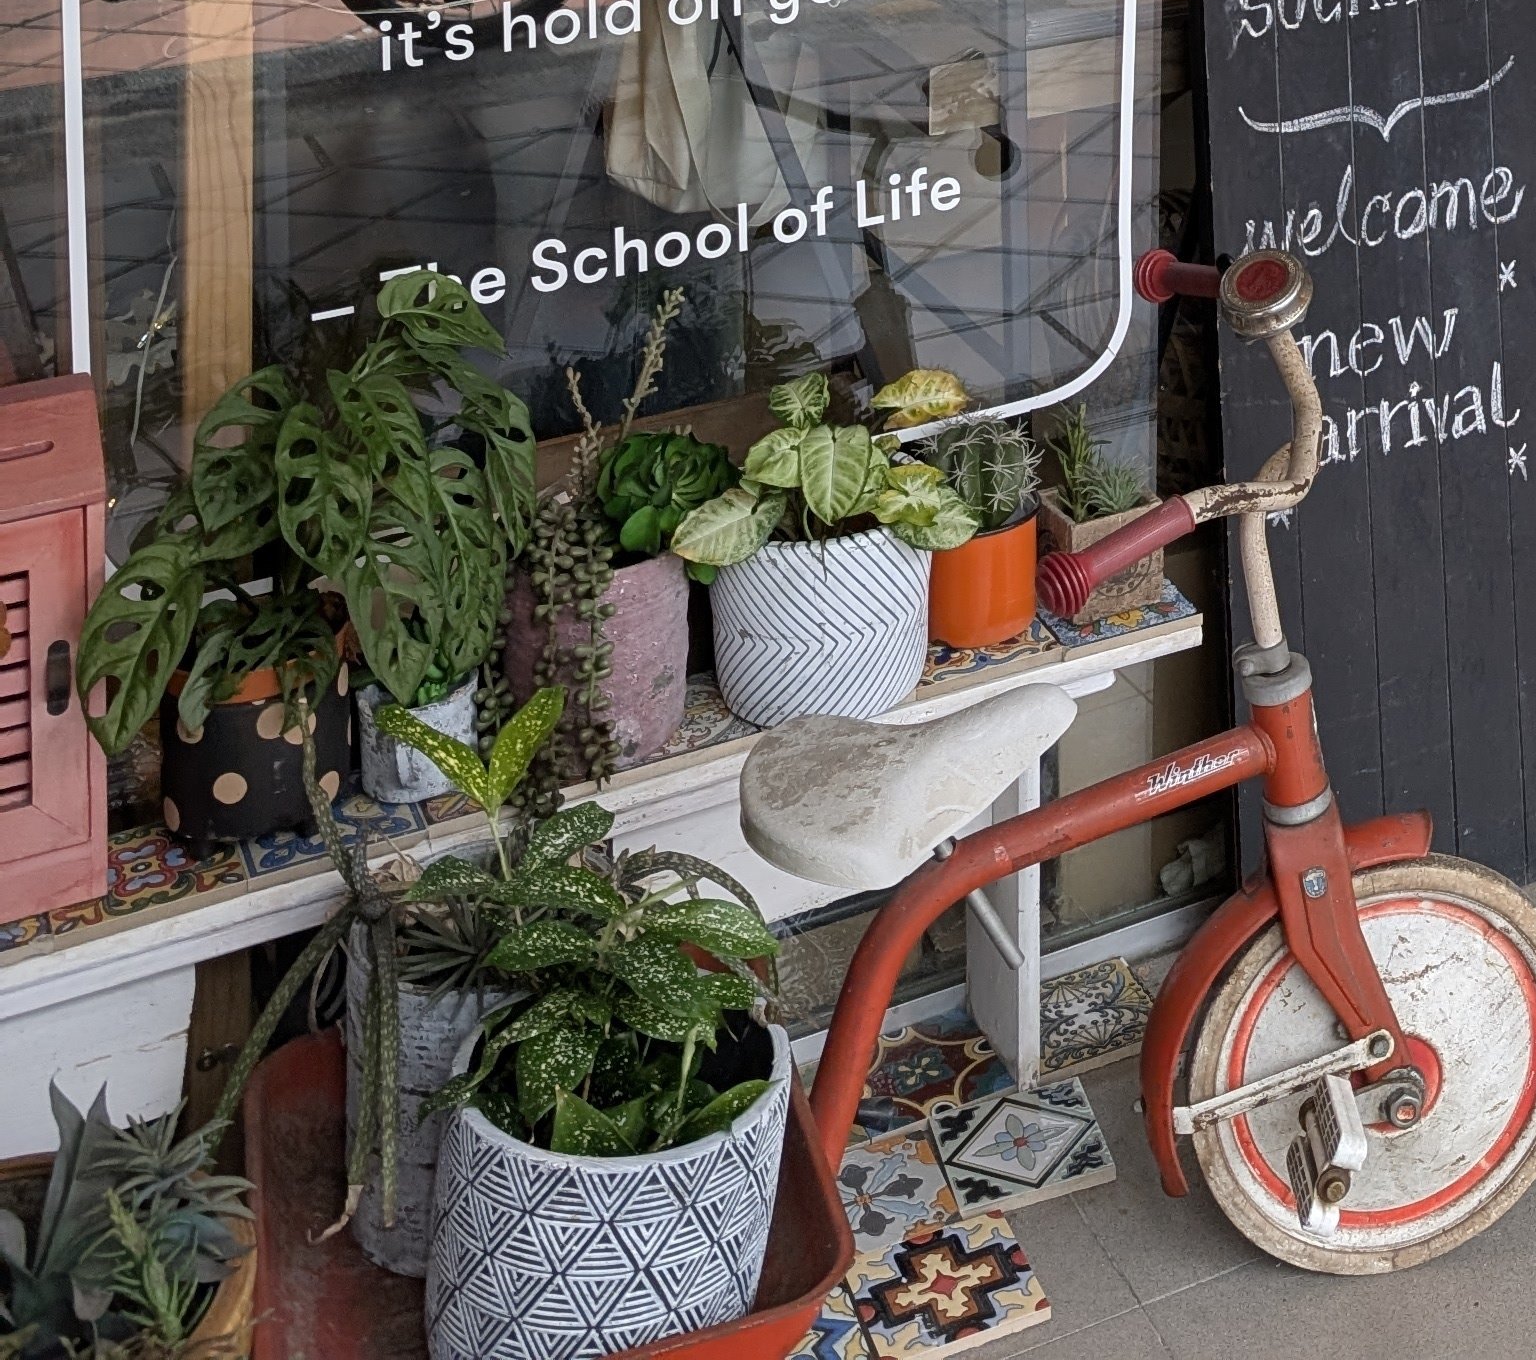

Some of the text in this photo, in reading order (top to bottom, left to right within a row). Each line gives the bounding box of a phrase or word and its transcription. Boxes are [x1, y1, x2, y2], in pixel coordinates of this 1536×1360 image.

[531, 202, 750, 294] School
[772, 185, 834, 246] of
[855, 166, 962, 228] Life
[1240, 163, 1527, 258] welcome
[1297, 307, 1460, 379] new
[1319, 360, 1521, 467] arrival
[1147, 748, 1240, 796] Winther
